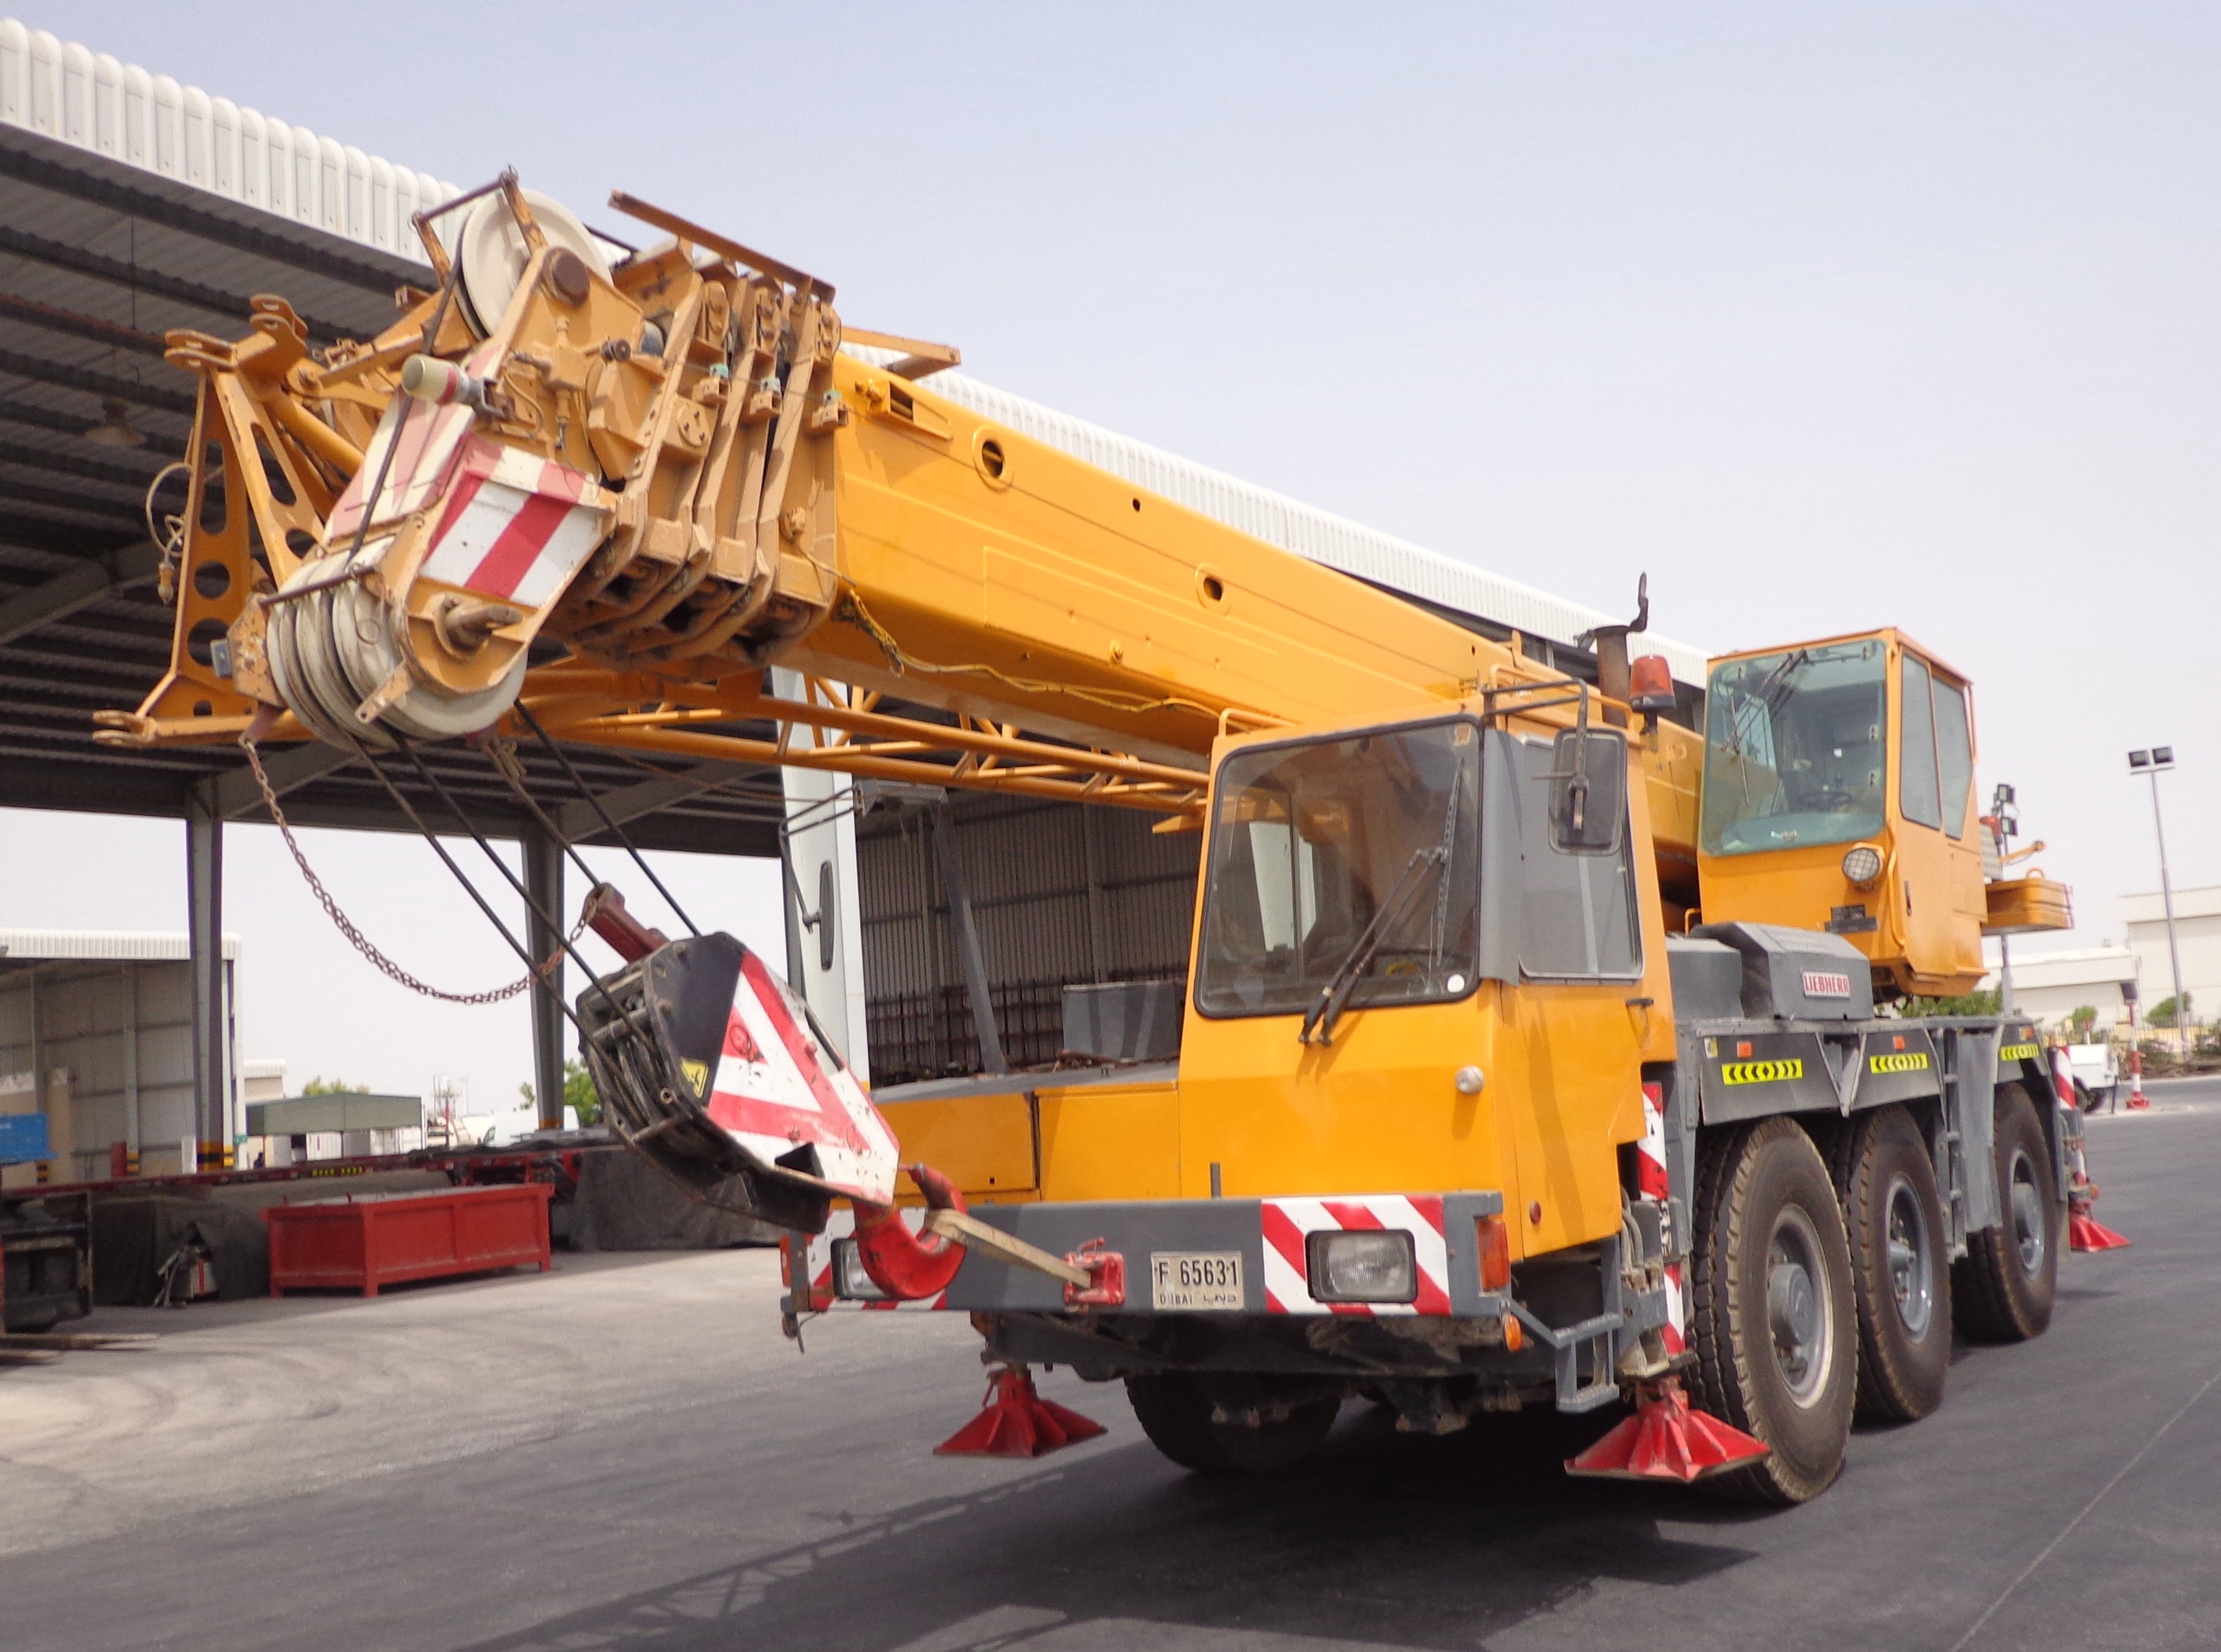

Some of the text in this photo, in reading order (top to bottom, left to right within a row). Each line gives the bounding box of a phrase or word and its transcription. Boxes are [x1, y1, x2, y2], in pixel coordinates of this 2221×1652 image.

[1804, 974, 1849, 992] LIEBHERR
[1159, 1260, 1237, 1287] F 65631
